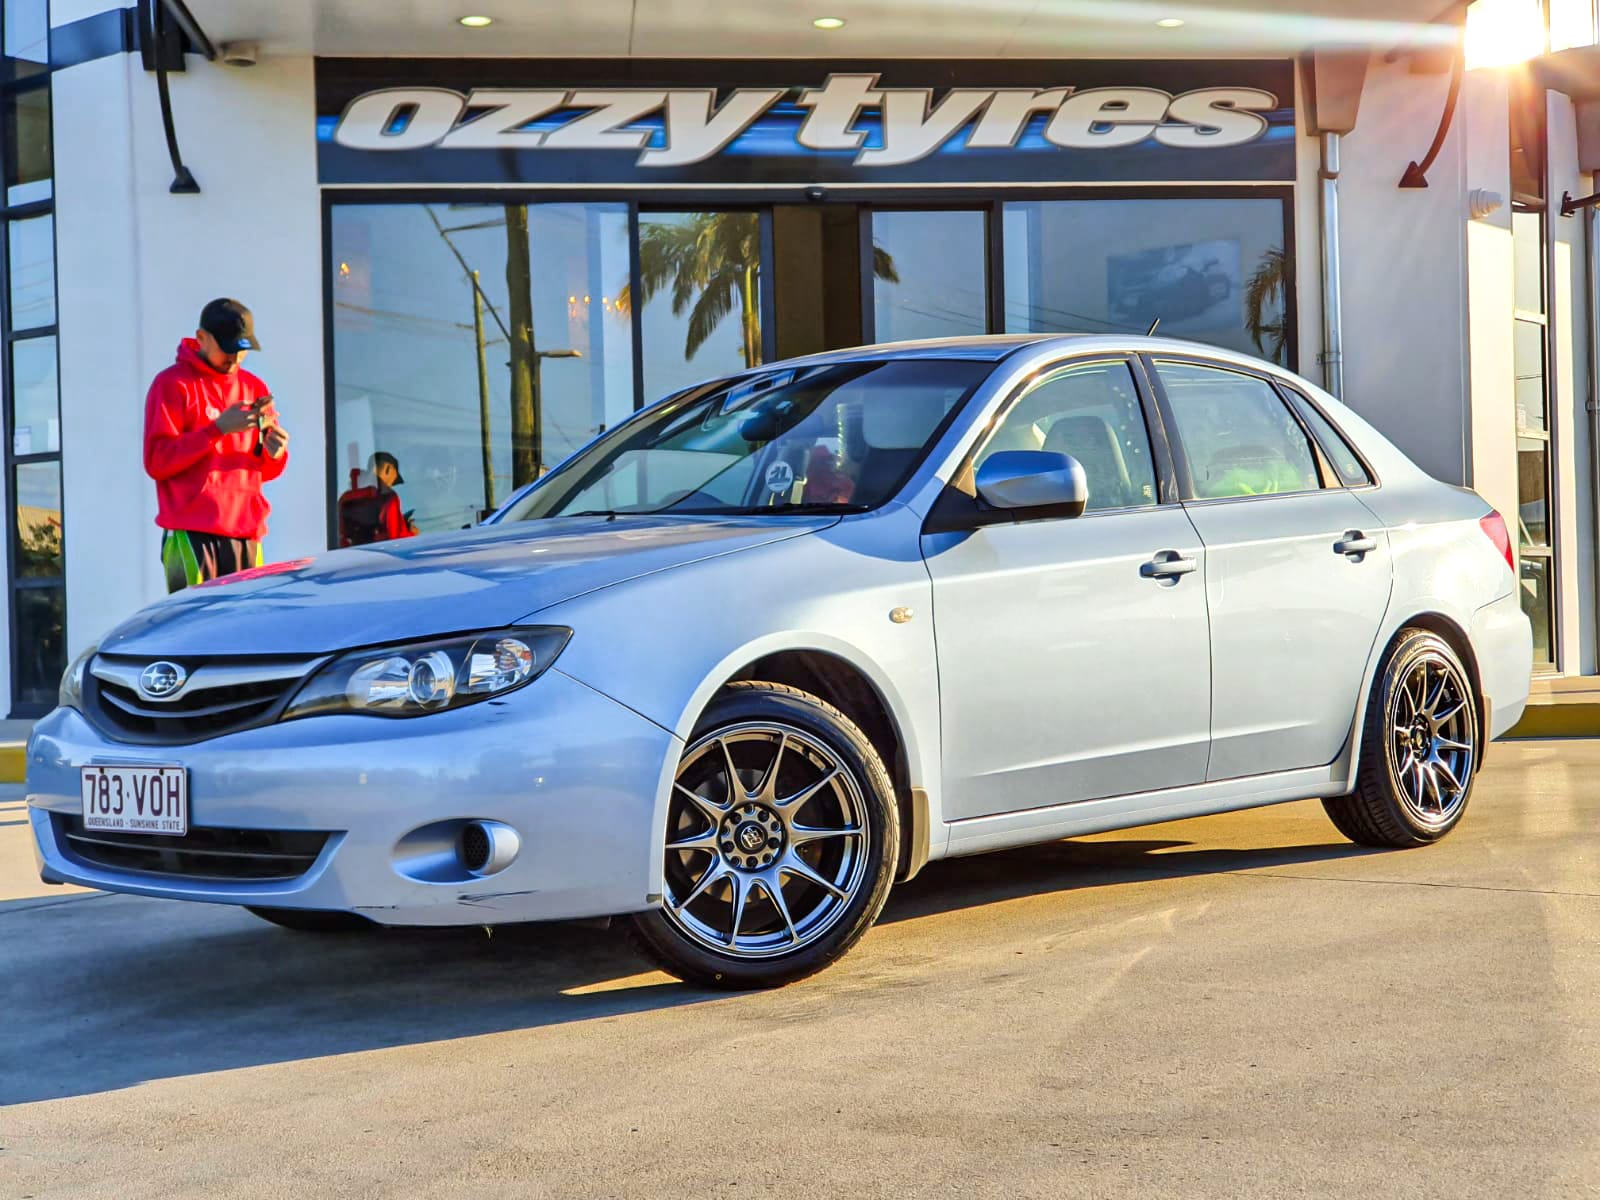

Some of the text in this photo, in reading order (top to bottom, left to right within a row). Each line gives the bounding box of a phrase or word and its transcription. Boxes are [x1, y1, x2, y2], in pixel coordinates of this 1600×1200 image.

[334, 72, 1278, 167] ozzy tyres
[88, 816, 180, 831] QUEENSLAND SUNSHINE STATE
